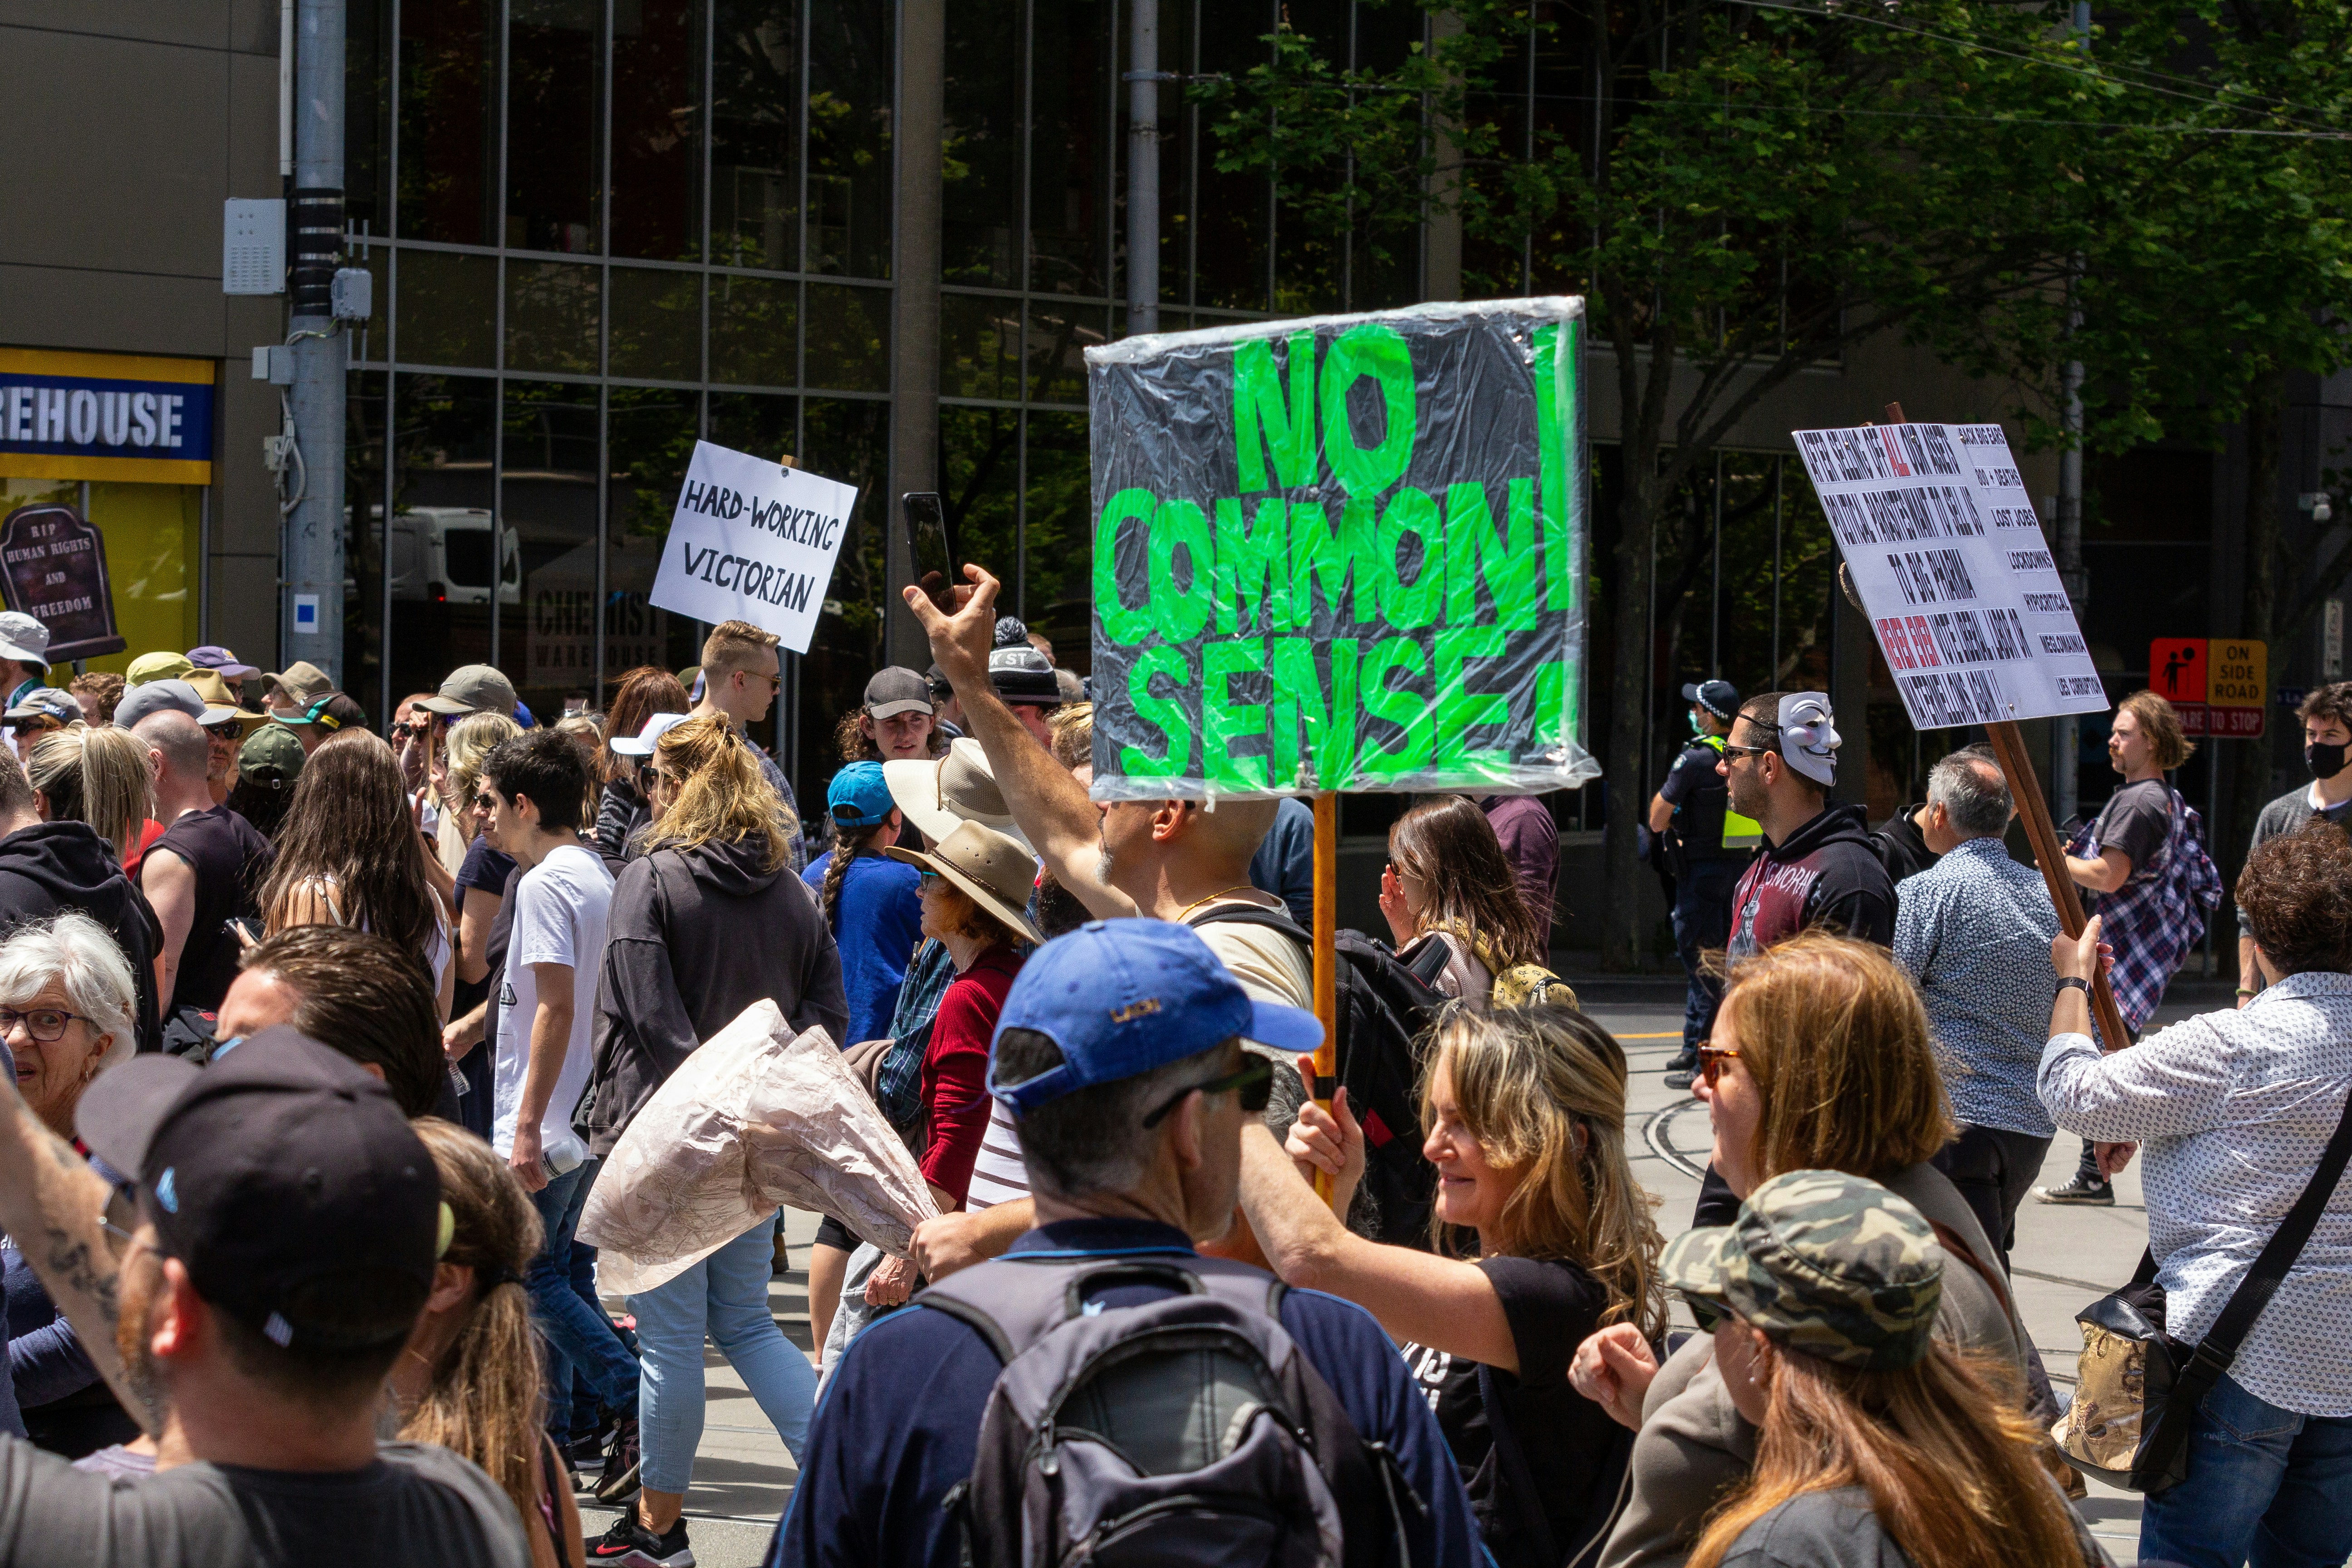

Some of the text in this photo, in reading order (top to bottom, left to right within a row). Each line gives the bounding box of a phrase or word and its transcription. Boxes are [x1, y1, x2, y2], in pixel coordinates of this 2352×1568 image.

[0, 387, 183, 447] EHOUSE
[1233, 323, 1416, 499] NO
[1958, 427, 2005, 445] SACK BIG EARS
[1799, 425, 1960, 483] AFTER SELLING OFF ALL OUR ASSETS
[1975, 469, 1989, 486] 800
[1994, 469, 2021, 486] DEATHS
[683, 480, 839, 550] HARD-WORKING
[1823, 485, 1984, 545] POLITICAL PARASITES WANT TO SELL US
[1991, 509, 2037, 527] LOST JOBS
[6, 538, 91, 563] HUMAN RIGHTS
[1094, 477, 1536, 646] COMMON
[2007, 551, 2053, 569] LOCKDOWNS
[46, 572, 66, 585] AND
[685, 542, 815, 613] VICTORIAN
[1887, 549, 1977, 604] TO BIG PHARMA
[31, 596, 93, 618] FREEDOM
[2024, 593, 2070, 612] HYPOCRITICAL
[1875, 617, 1918, 670] NEVER
[1905, 616, 1942, 668] EVER
[1927, 613, 1964, 665] VOTE
[1983, 608, 2020, 660] LABOR
[2008, 608, 2033, 658] OR
[536, 645, 656, 667] WAREOUSE
[1006, 653, 1027, 666] ST
[2226, 646, 2249, 661] ON
[2220, 665, 2254, 680] SIDE
[2056, 677, 2102, 696] LIES CORRUPTION
[2215, 684, 2259, 699] ROAD
[1898, 672, 1977, 727] WATERMELLONS
[1965, 670, 2001, 721] AGAIN
[2210, 711, 2224, 730] TO
[2231, 712, 2260, 731] STOP
